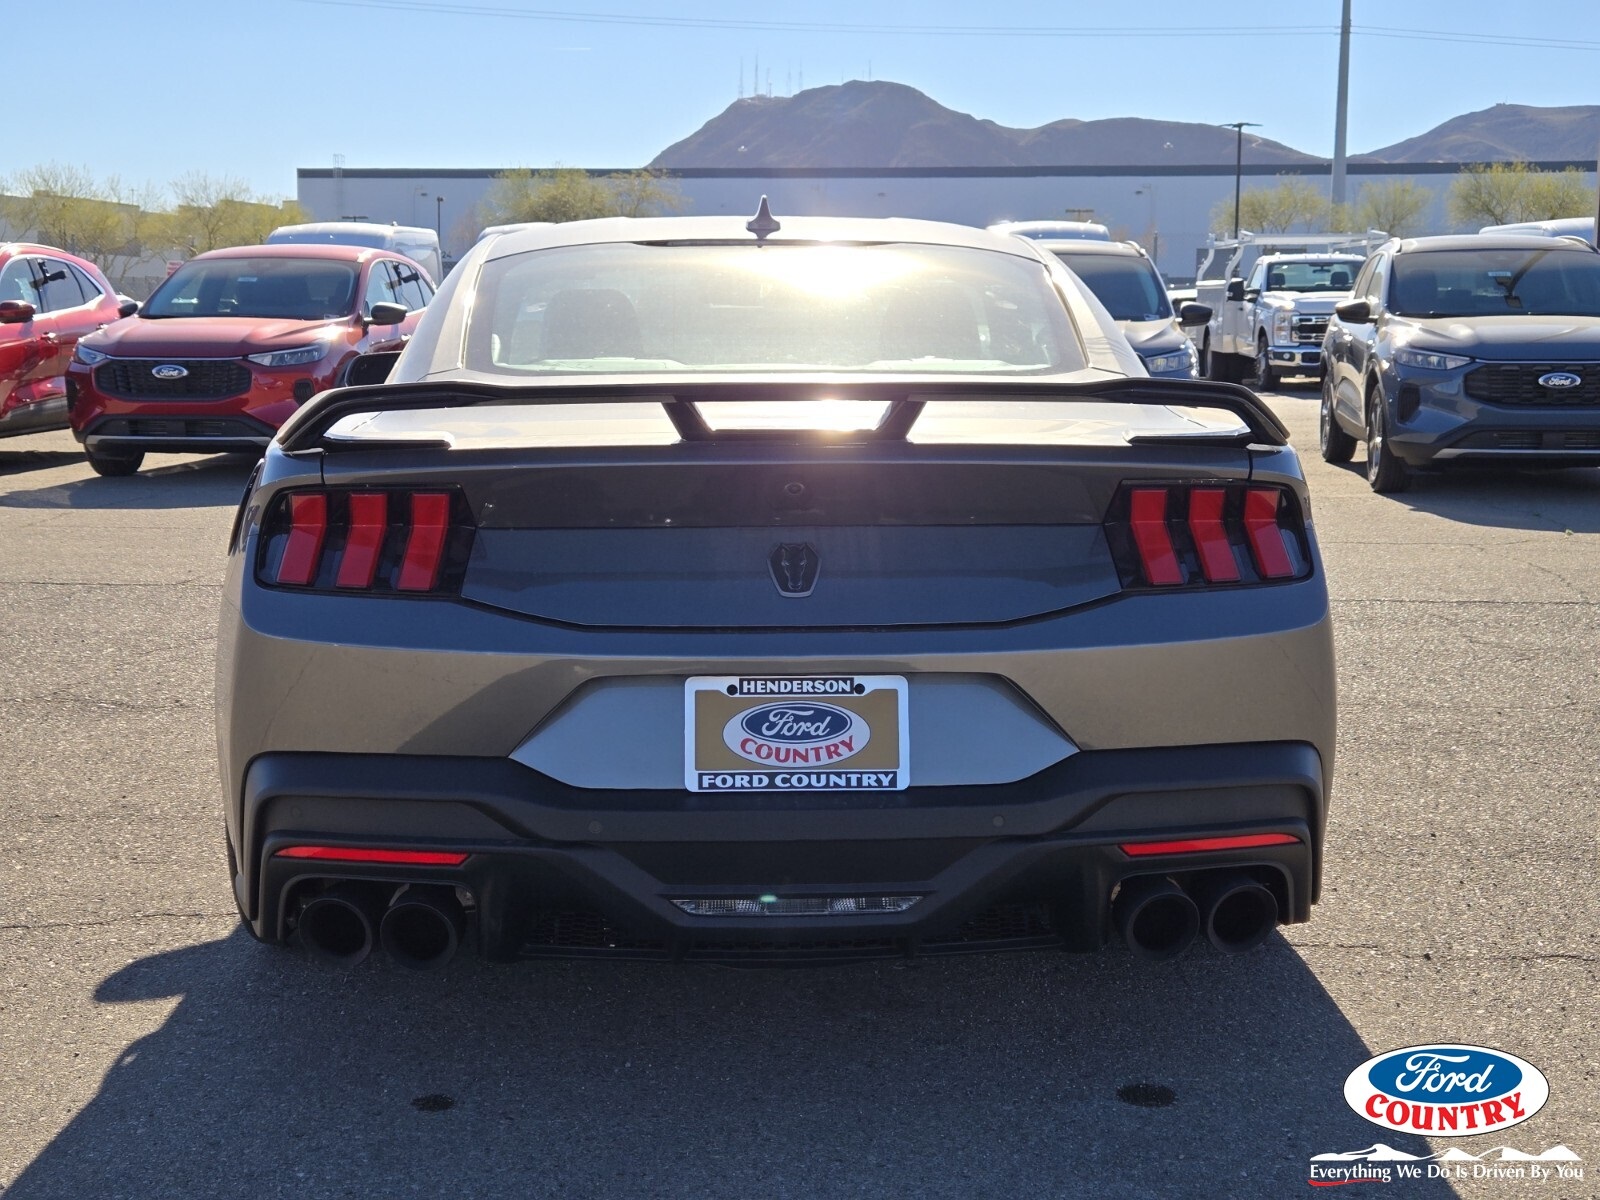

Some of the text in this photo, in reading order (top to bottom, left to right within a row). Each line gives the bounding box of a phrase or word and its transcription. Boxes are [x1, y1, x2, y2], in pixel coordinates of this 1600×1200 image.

[742, 680, 851, 693] HENDERSON
[761, 709, 831, 736] Ford
[740, 735, 855, 763] COUNTRY
[702, 773, 894, 788] FORD COUNTRY
